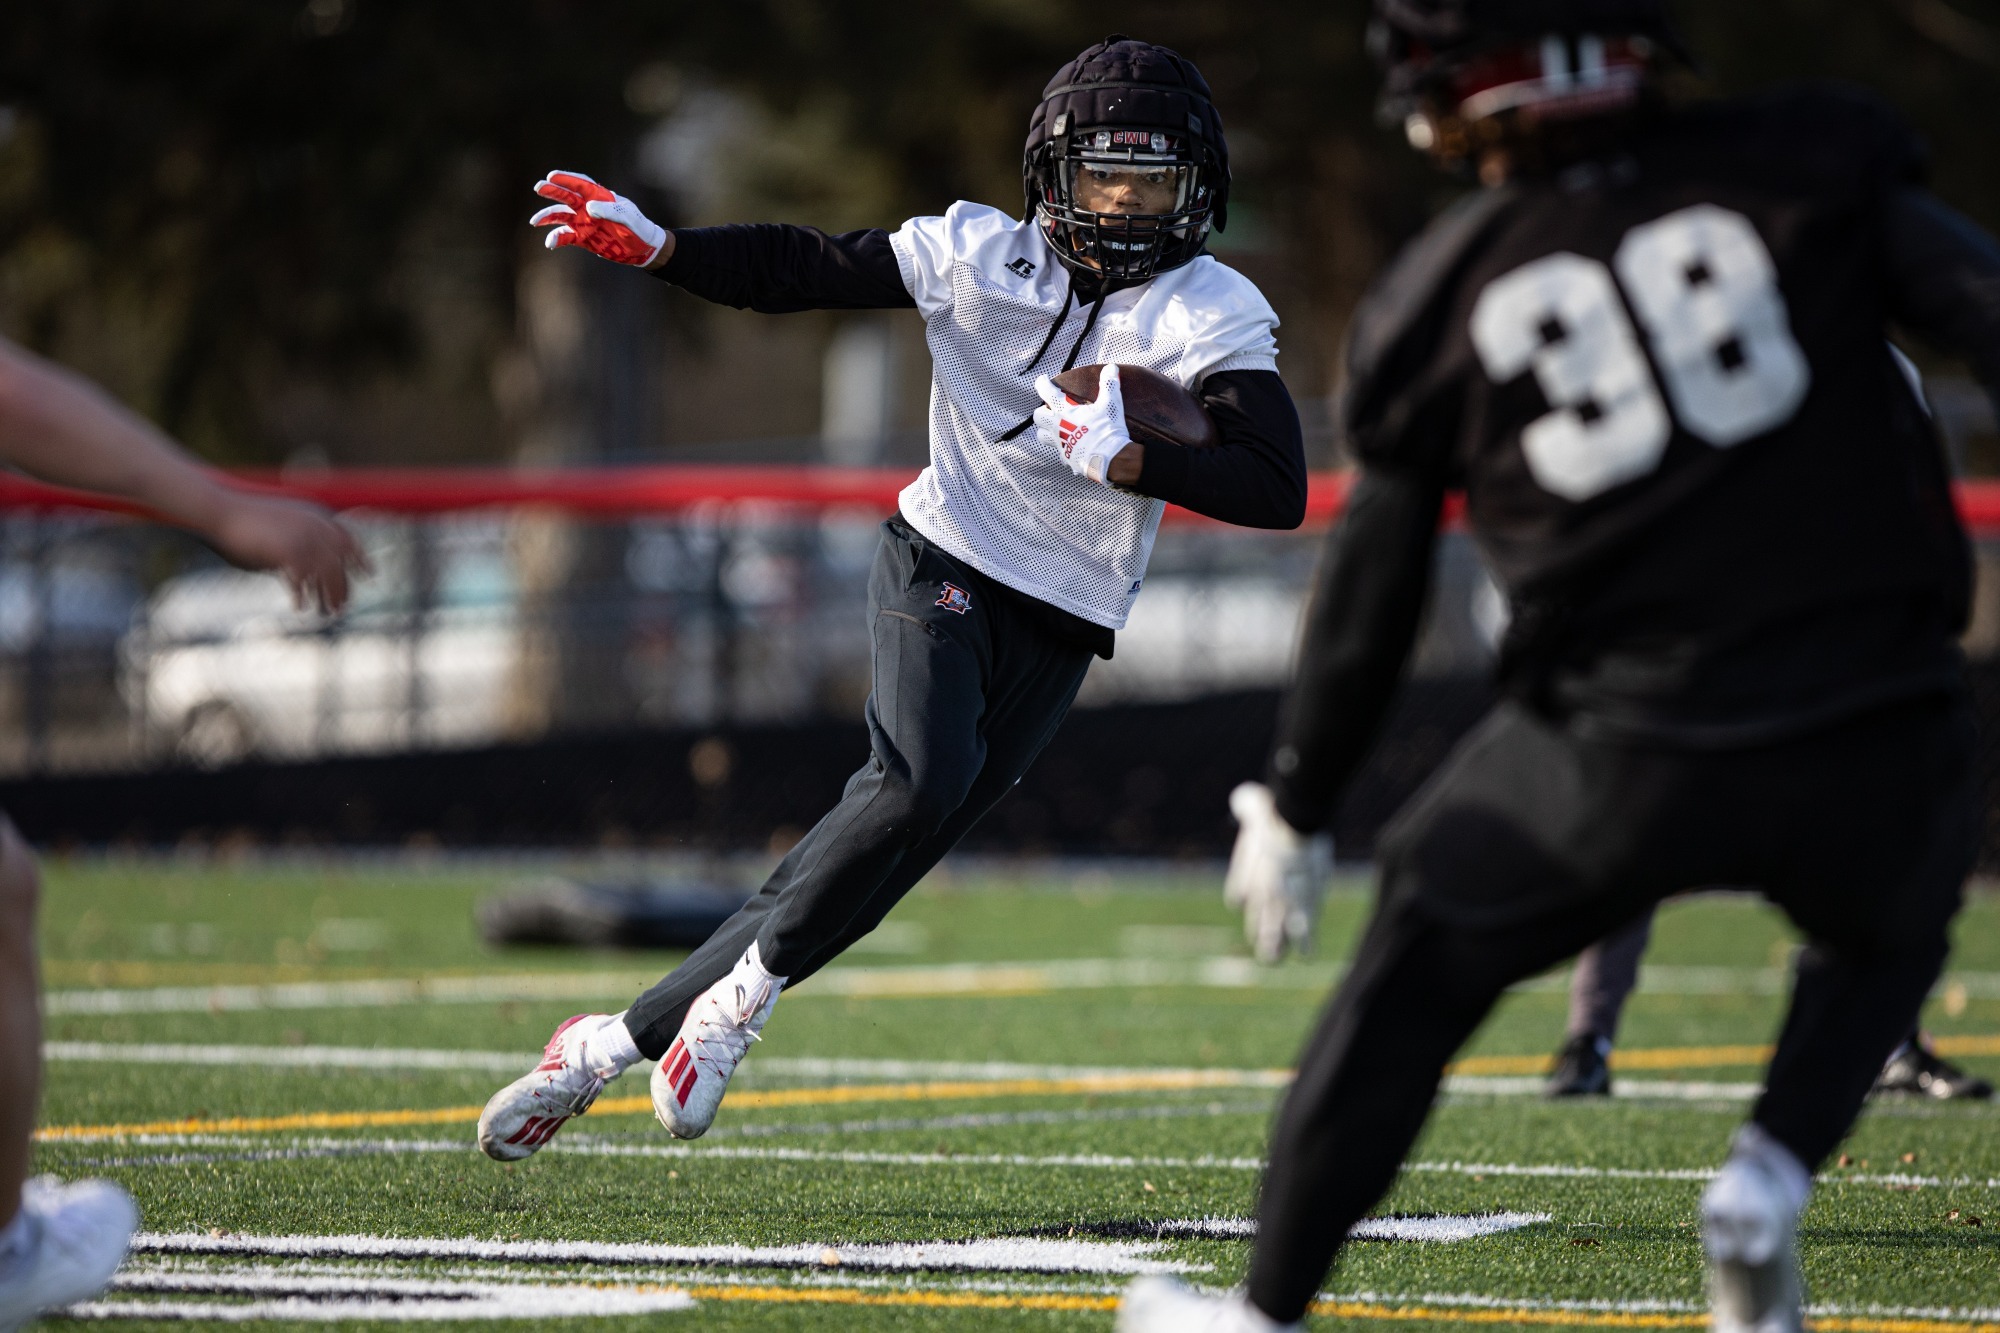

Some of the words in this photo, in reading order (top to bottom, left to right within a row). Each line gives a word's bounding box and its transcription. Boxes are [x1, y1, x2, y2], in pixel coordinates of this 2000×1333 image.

[1114, 131, 1149, 145] CWU
[1468, 202, 1813, 502] 38
[1065, 425, 1089, 459] adidas
